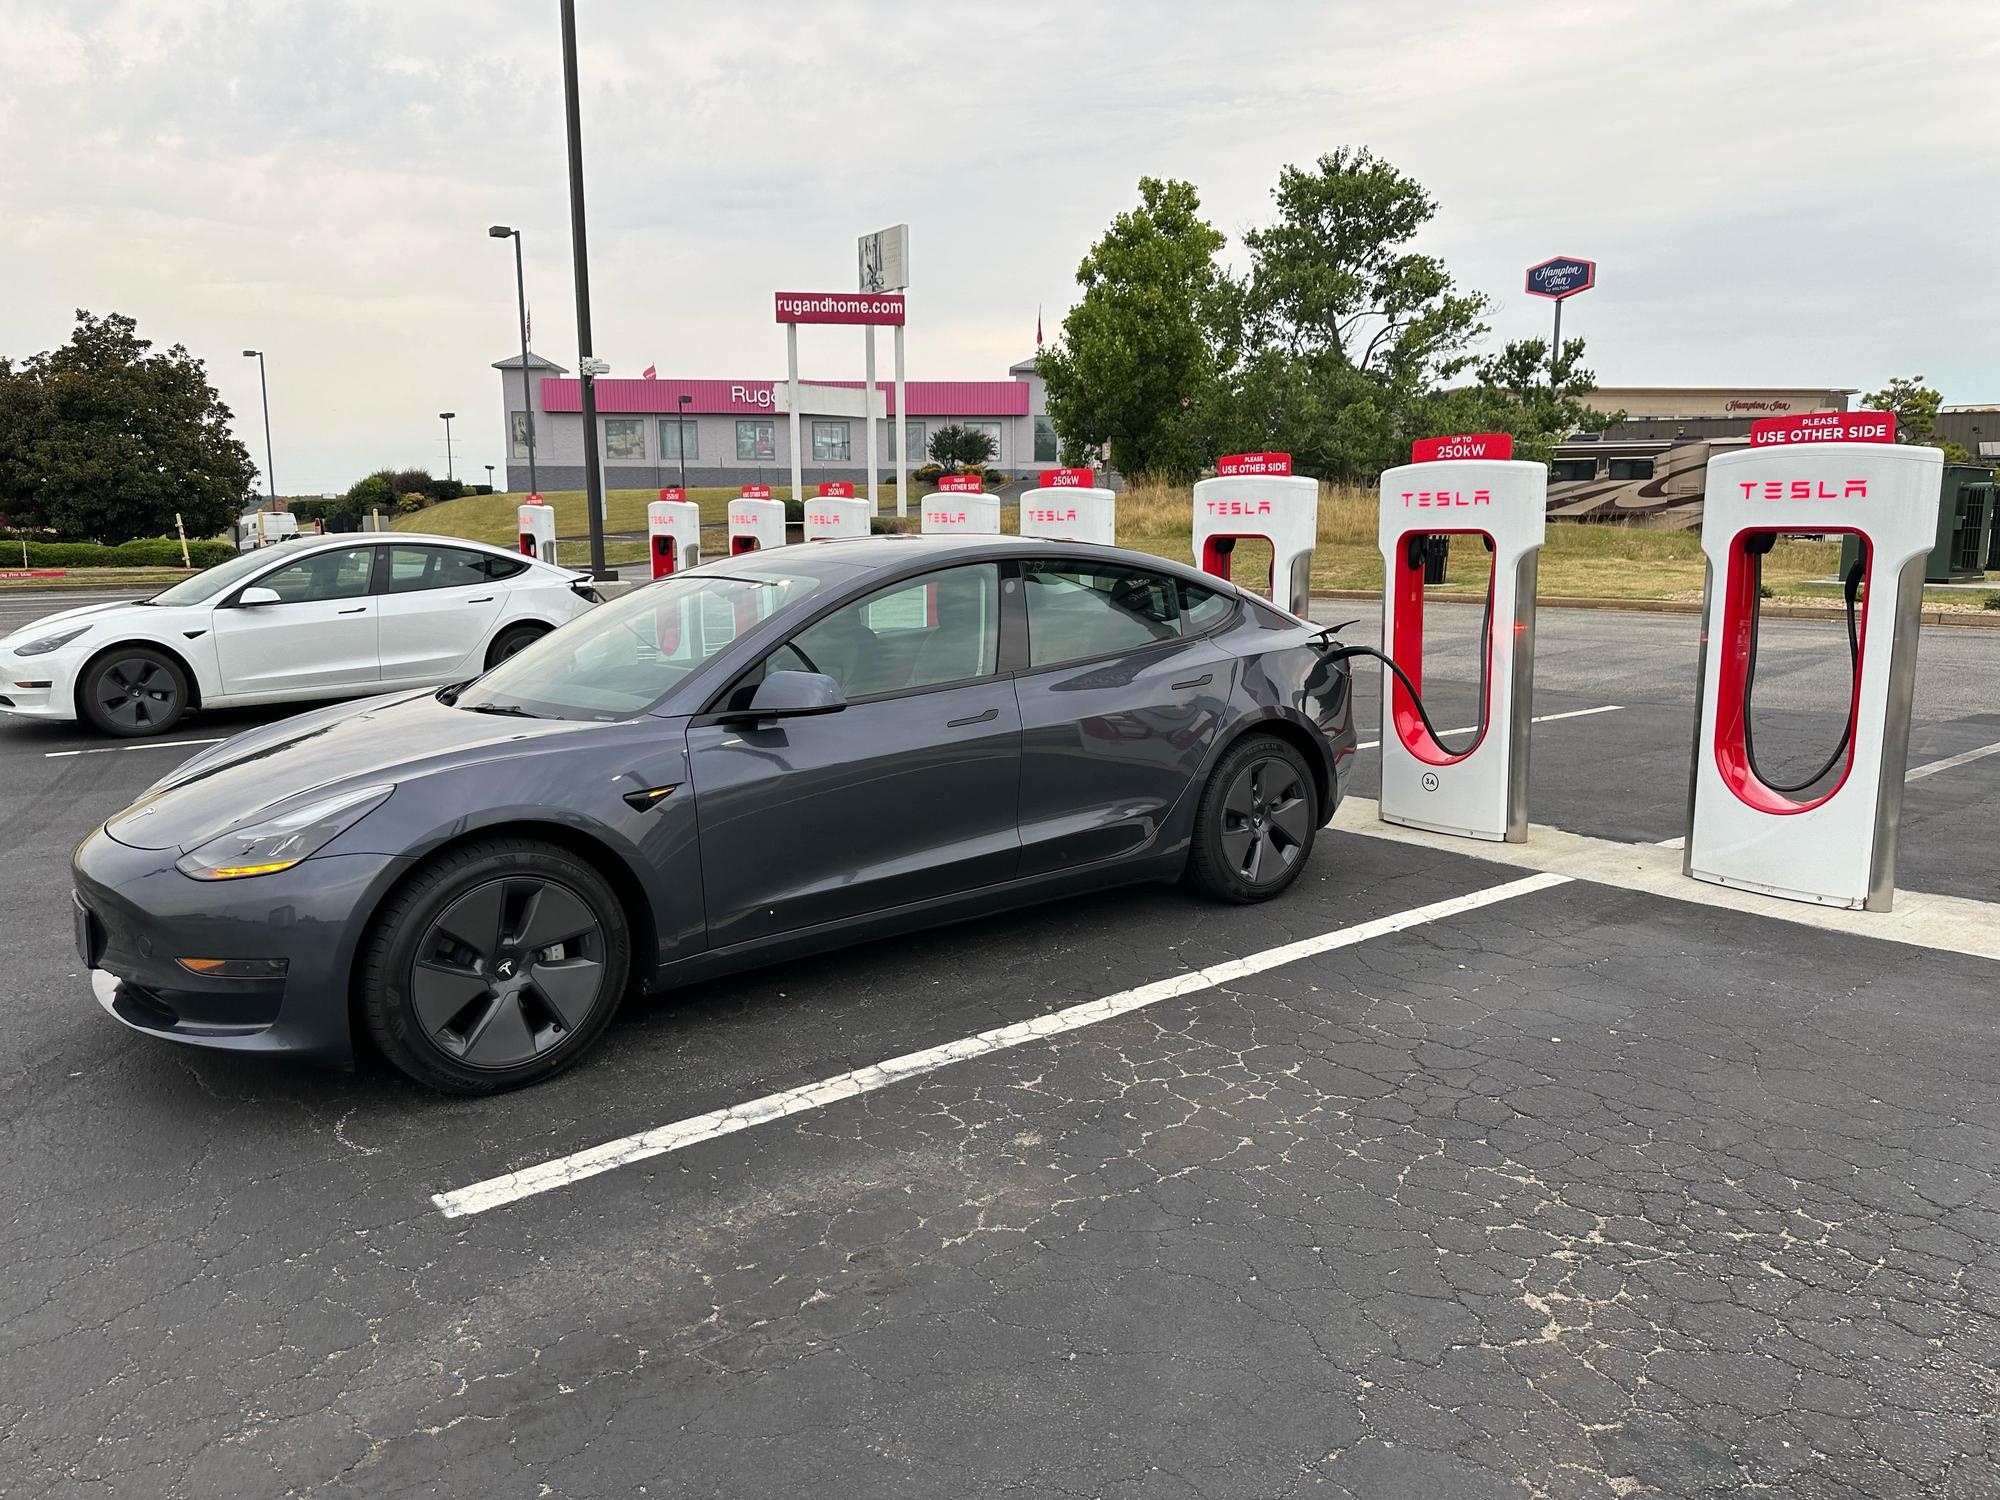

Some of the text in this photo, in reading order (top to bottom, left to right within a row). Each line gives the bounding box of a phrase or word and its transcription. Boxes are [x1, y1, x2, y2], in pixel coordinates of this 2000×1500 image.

[1535, 265, 1583, 281] Hampton
[1545, 275, 1571, 288] Inn
[777, 297, 903, 315] rugandhome.com
[1725, 400, 1791, 411] Hampton Inn
[1802, 416, 1840, 427] PLEASE
[1757, 425, 1887, 443] USE OTHER SIDE
[1437, 443, 1486, 459] 250kW
[1244, 455, 1264, 463] PLEASE
[1222, 462, 1287, 474] USE OTHER SIDE
[1052, 475, 1079, 486] 250kW
[827, 488, 845, 496] 250kW
[940, 482, 979, 492] USE OTHER SIDE
[1739, 480, 1868, 500] TESLA
[1401, 490, 1490, 507] TESLA
[1206, 501, 1271, 515] TESLA
[731, 514, 758, 524] TESLA
[809, 514, 840, 525] TESLA
[927, 512, 966, 524] TESLA
[1028, 510, 1077, 522] TESLA
[1425, 777, 1435, 786] 3A
